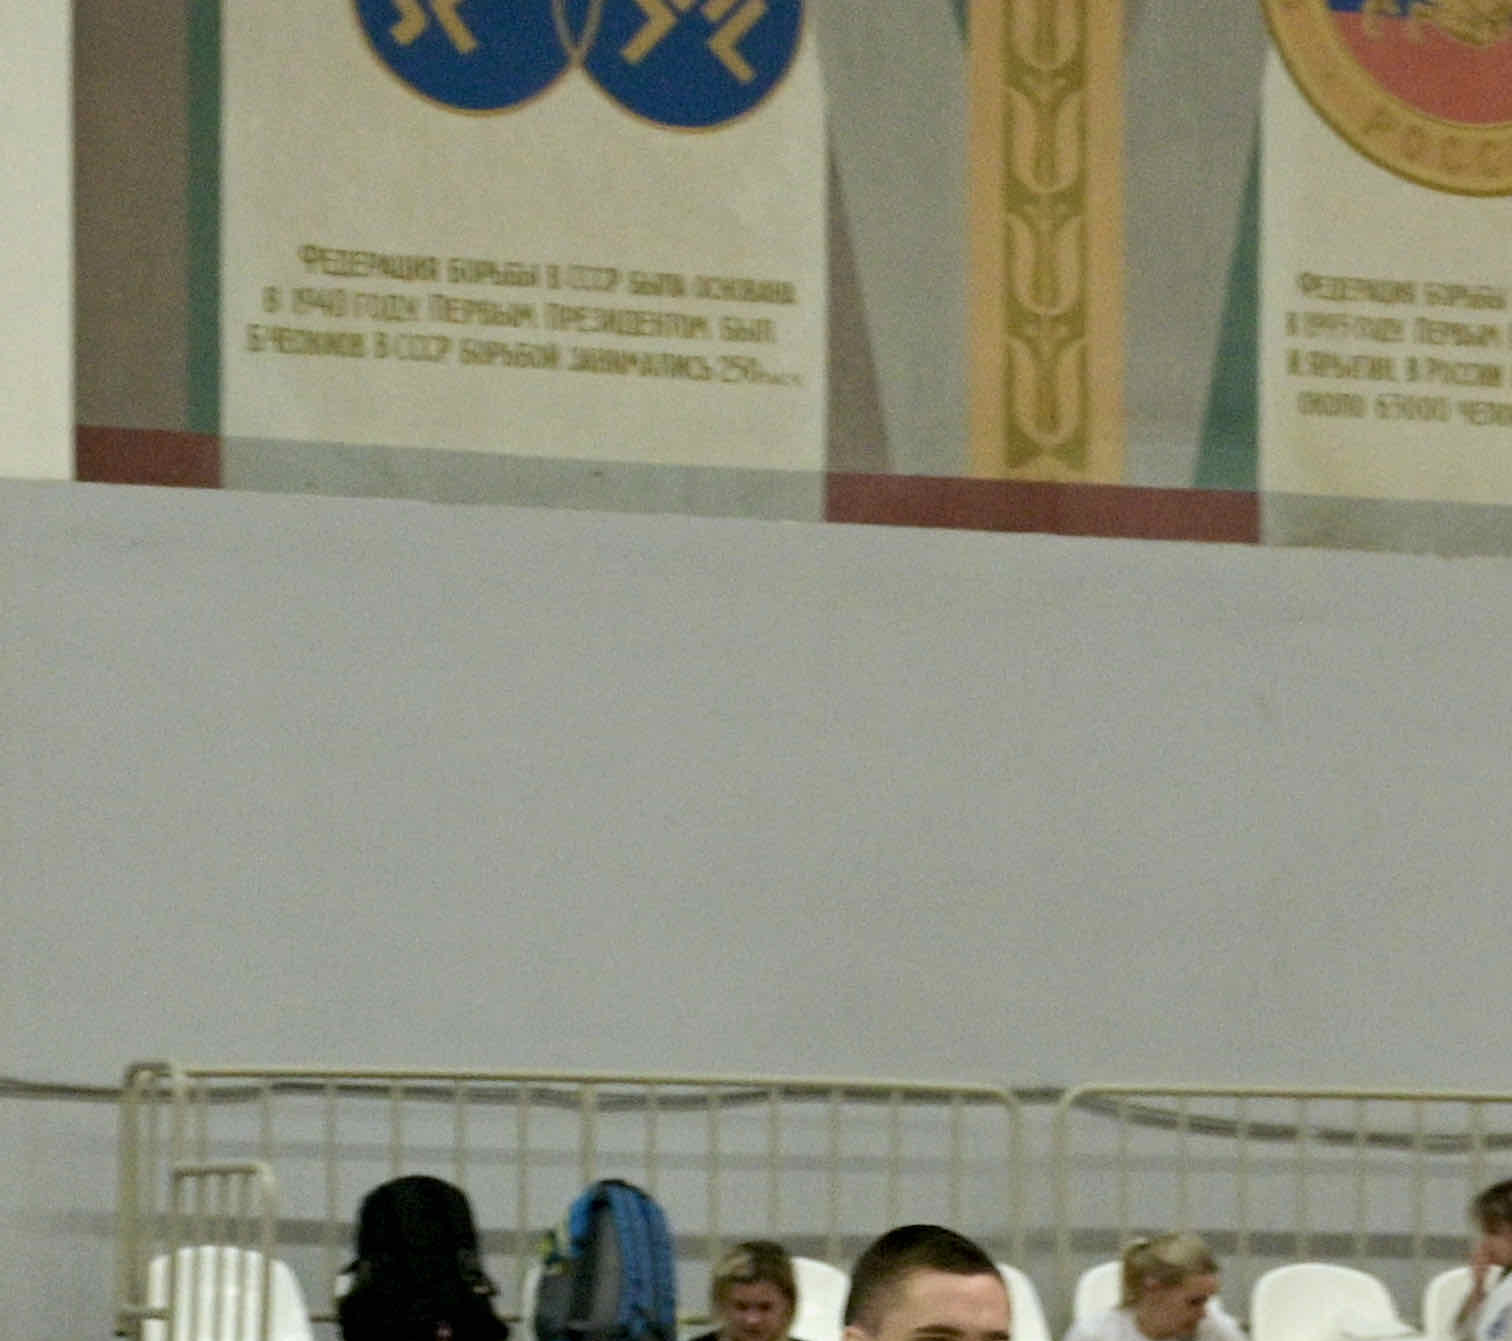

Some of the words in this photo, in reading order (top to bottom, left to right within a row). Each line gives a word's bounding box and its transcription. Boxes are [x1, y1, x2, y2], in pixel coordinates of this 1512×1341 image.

[296, 243, 441, 284] ФЕДЕРАЦИЯ
[446, 256, 538, 287] БОРЬБЫ
[563, 264, 619, 293] СССР
[1295, 270, 1417, 305] ФЕДЕРАЦИЯ
[428, 294, 534, 328] ПЕРВЫМ
[543, 302, 711, 340] ПРЕЗИДЕНТОМ
[391, 332, 452, 362] СССР
